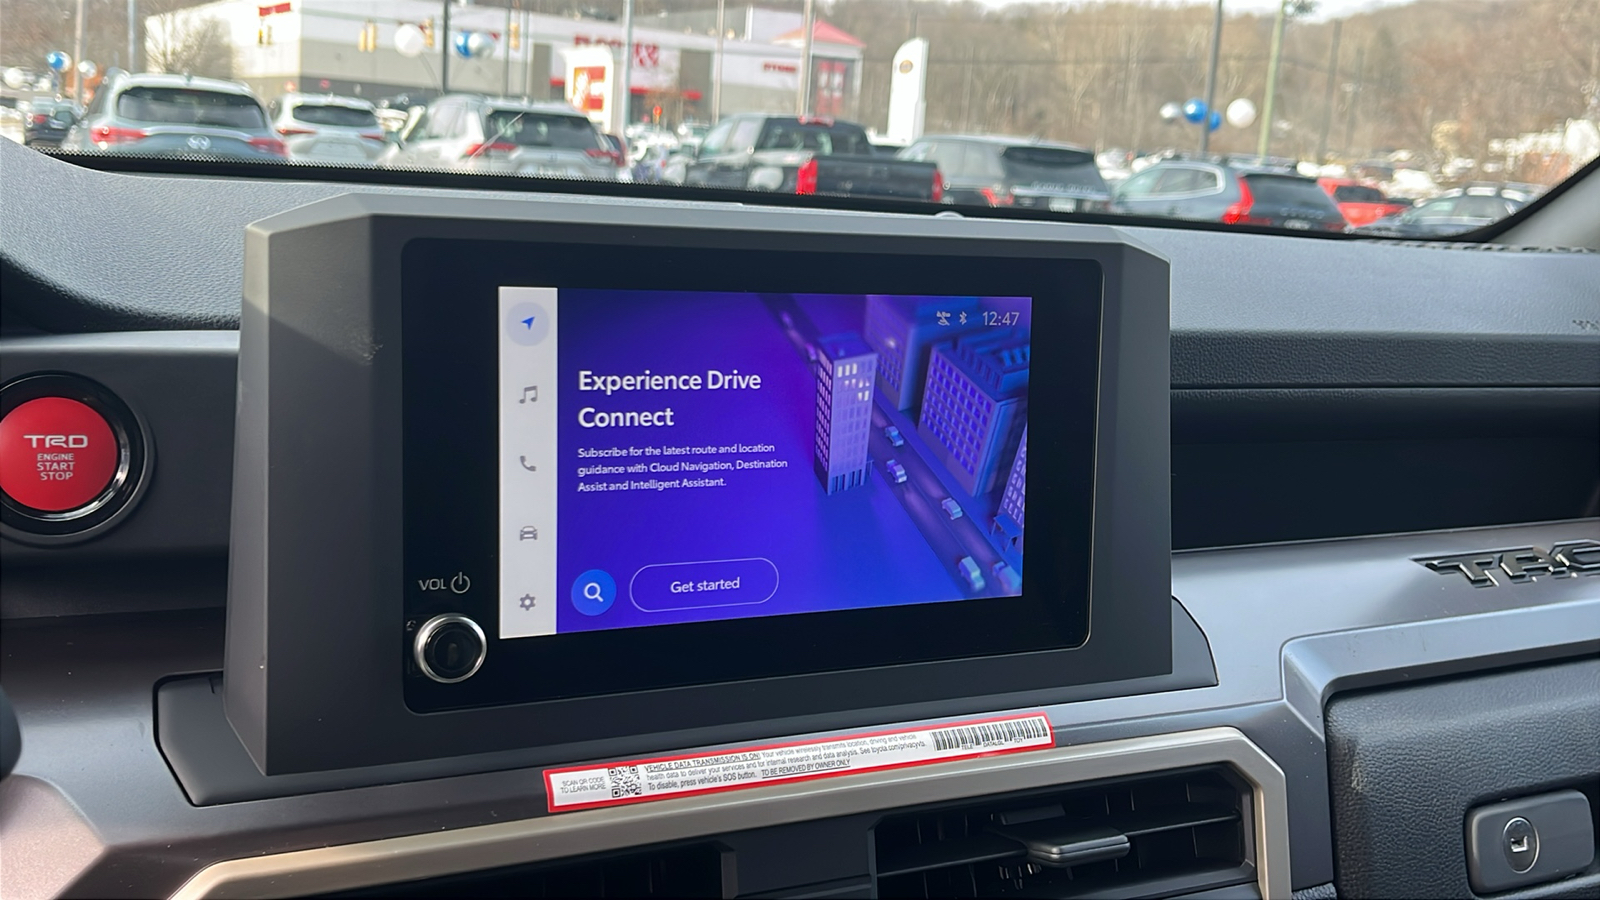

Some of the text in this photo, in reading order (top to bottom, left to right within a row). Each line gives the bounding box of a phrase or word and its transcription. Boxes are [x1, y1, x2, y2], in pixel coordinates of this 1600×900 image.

[982, 311, 1020, 326] 12:47
[578, 369, 762, 395] Experience Drive
[577, 406, 675, 428] Connect
[23, 434, 89, 449] TRD
[36, 453, 75, 461] ENGINE
[577, 443, 775, 458] Subscribe for the latest route and location
[36, 461, 75, 471] START
[577, 459, 788, 478] guidance with Cloud Navigation, Destination
[40, 471, 74, 481] STOP
[577, 477, 727, 493] Assist and Intelligent Assistant.
[418, 578, 448, 591] VOL
[670, 576, 741, 594] Get started
[643, 761, 674, 773] VEHICLE
[674, 760, 691, 770] DATA
[692, 755, 741, 767] TRANSMISSION
[741, 753, 748, 762] IS
[761, 751, 774, 760] Your
[775, 748, 794, 757] vehicle
[795, 745, 821, 755] wirelessly
[821, 743, 847, 752] transmits
[847, 739, 870, 749] location,
[869, 736, 886, 746] driving
[887, 735, 898, 743] and
[898, 733, 917, 741] vehicle
[961, 743, 974, 751] TELE
[646, 772, 665, 782] health
[665, 770, 680, 780] data
[687, 767, 707, 777] deliver
[708, 766, 721, 776] your
[721, 762, 745, 773] services
[745, 761, 757, 770] and
[757, 760, 766, 769] for
[766, 756, 787, 766] internal
[787, 754, 811, 765] research
[811, 753, 823, 762] and
[823, 750, 836, 760] data
[859, 746, 871, 755] See
[561, 779, 578, 788] SCAN
[588, 775, 605, 785] CODE
[648, 758, 851, 791] To disable, press vehicle's SOS button. TO BE REMOVED BY OWNER ONLY
[560, 782, 607, 795] TO LEARN MORE
